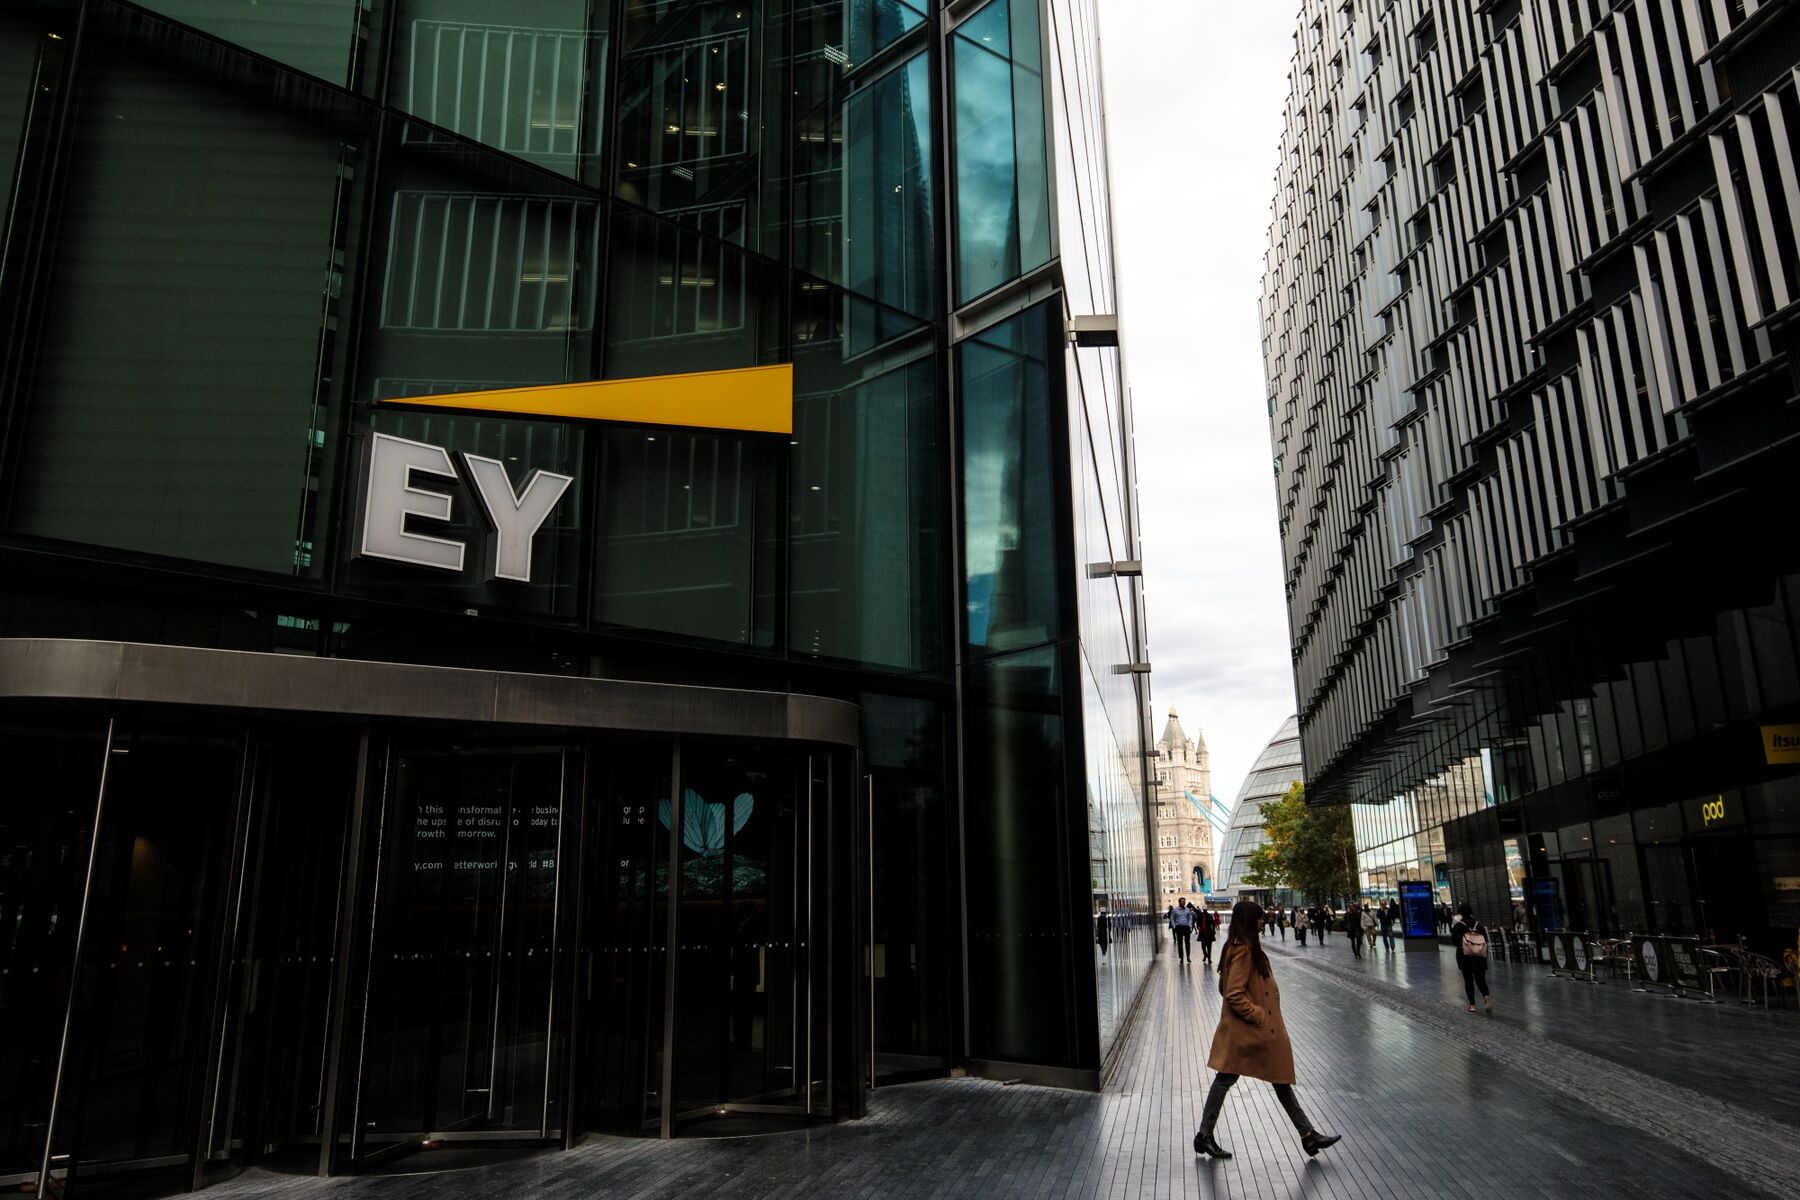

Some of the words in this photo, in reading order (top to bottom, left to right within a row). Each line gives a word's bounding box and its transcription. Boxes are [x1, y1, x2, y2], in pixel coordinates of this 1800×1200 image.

[358, 431, 575, 583] EY
[1773, 734, 1800, 748] itsu
[425, 805, 444, 815] this
[1702, 794, 1725, 827] pod
[465, 817, 475, 826] of
[416, 829, 446, 838] rowth
[457, 830, 497, 838] morrow.
